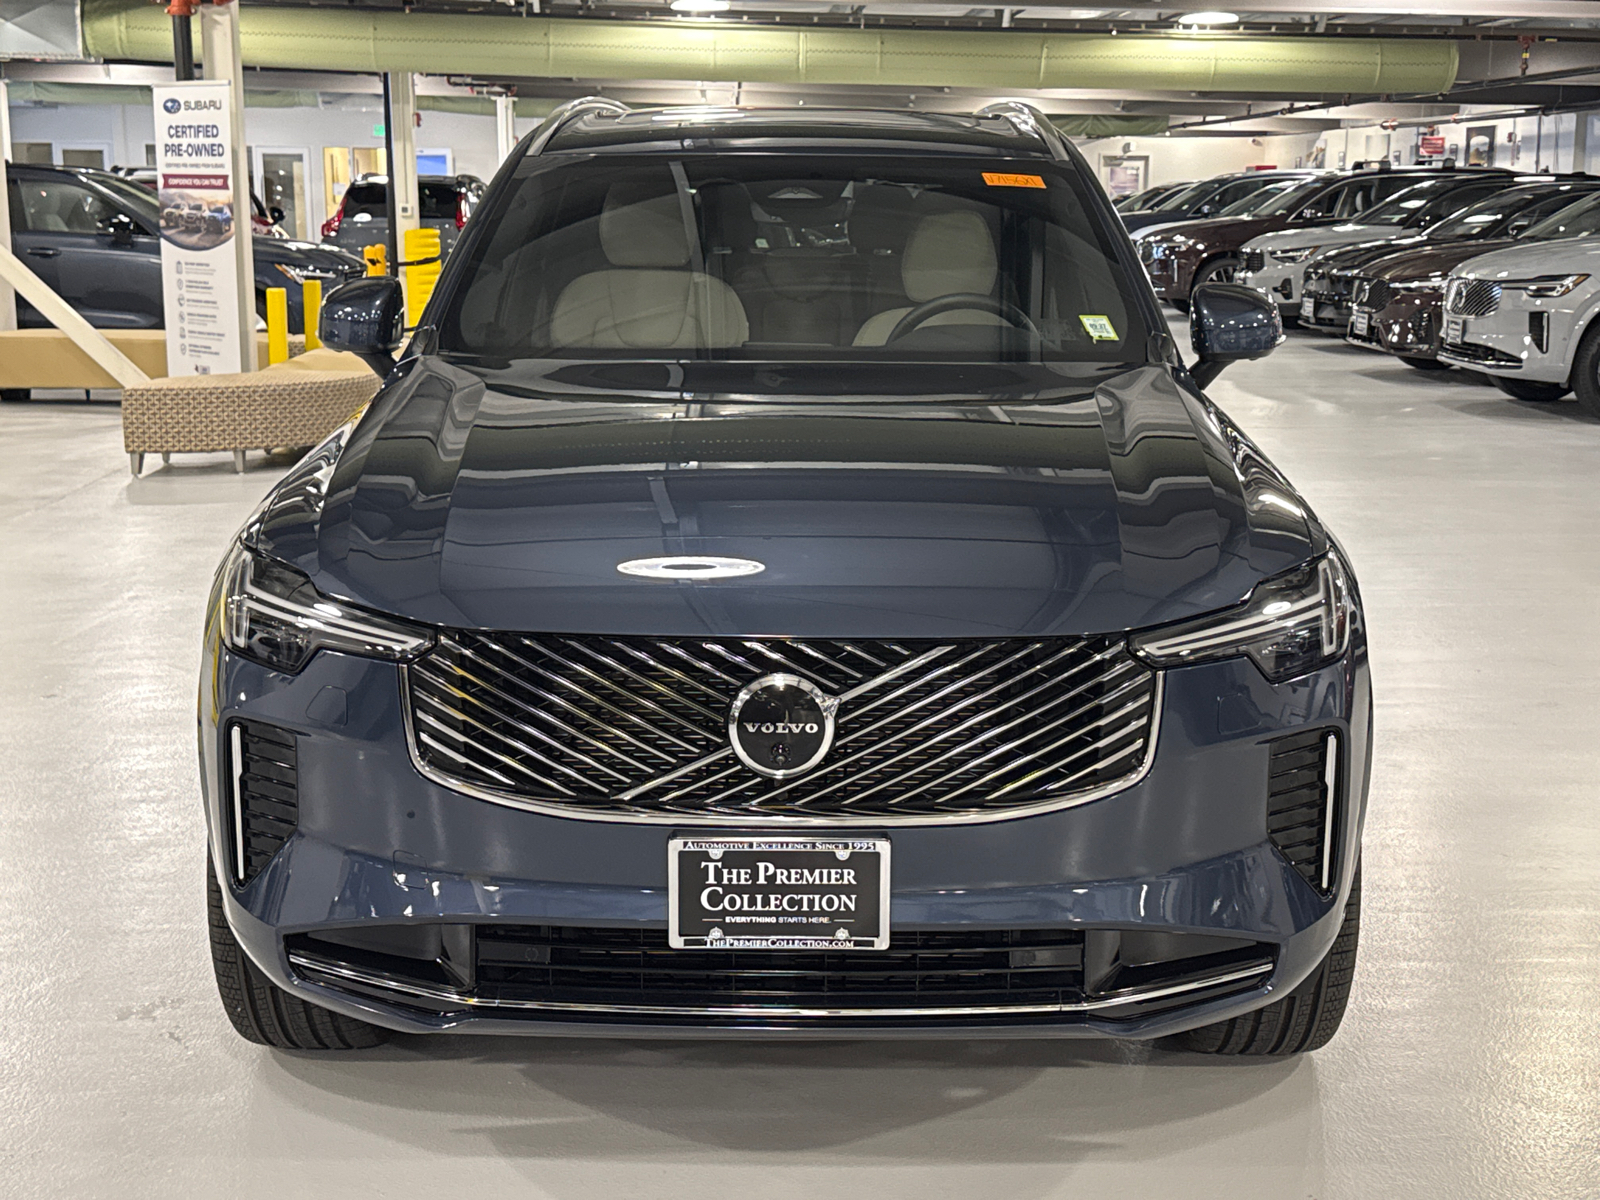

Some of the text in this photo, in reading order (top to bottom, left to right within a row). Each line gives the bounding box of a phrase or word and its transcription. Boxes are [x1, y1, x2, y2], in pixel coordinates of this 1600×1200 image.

[183, 100, 222, 111] SUBARU
[167, 124, 219, 139] CERTIFIED
[164, 143, 225, 157] PRE-OWNED
[743, 722, 819, 734] VOLVO
[685, 841, 875, 851] AUTOMOTIVE EXCELLENCE SINCE 1995
[701, 861, 857, 885] THE PREMIER
[700, 886, 857, 911] COLLECTION
[725, 916, 777, 924] EVERYTHING
[778, 916, 807, 924] STARTS
